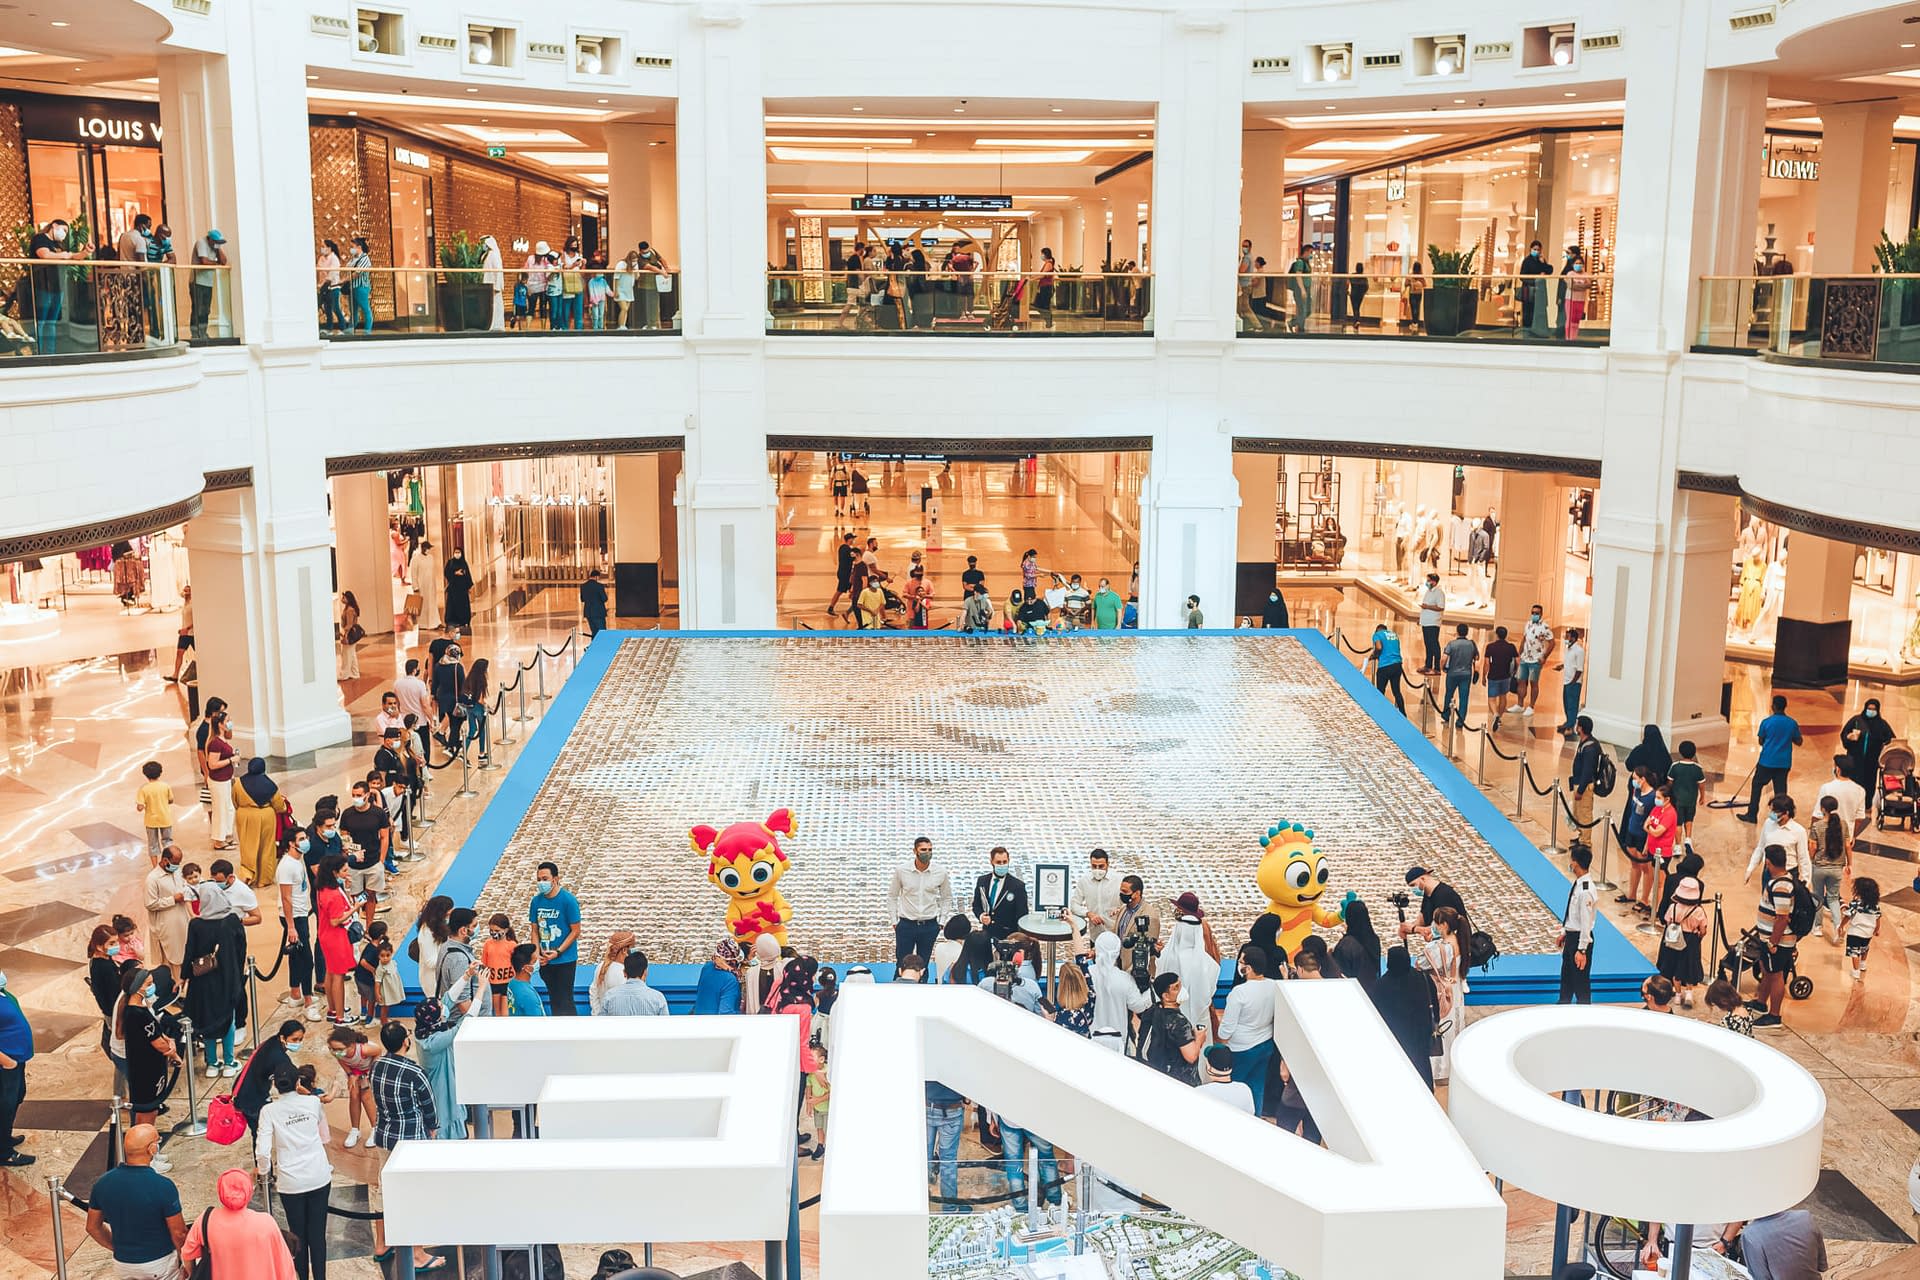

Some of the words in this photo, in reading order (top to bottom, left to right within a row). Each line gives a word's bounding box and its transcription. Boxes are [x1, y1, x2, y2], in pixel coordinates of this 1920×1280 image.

[78, 117, 144, 141] LOUIS
[1770, 159, 1819, 179] LOEWE
[530, 494, 590, 506] ZARA
[537, 907, 560, 919] Funko
